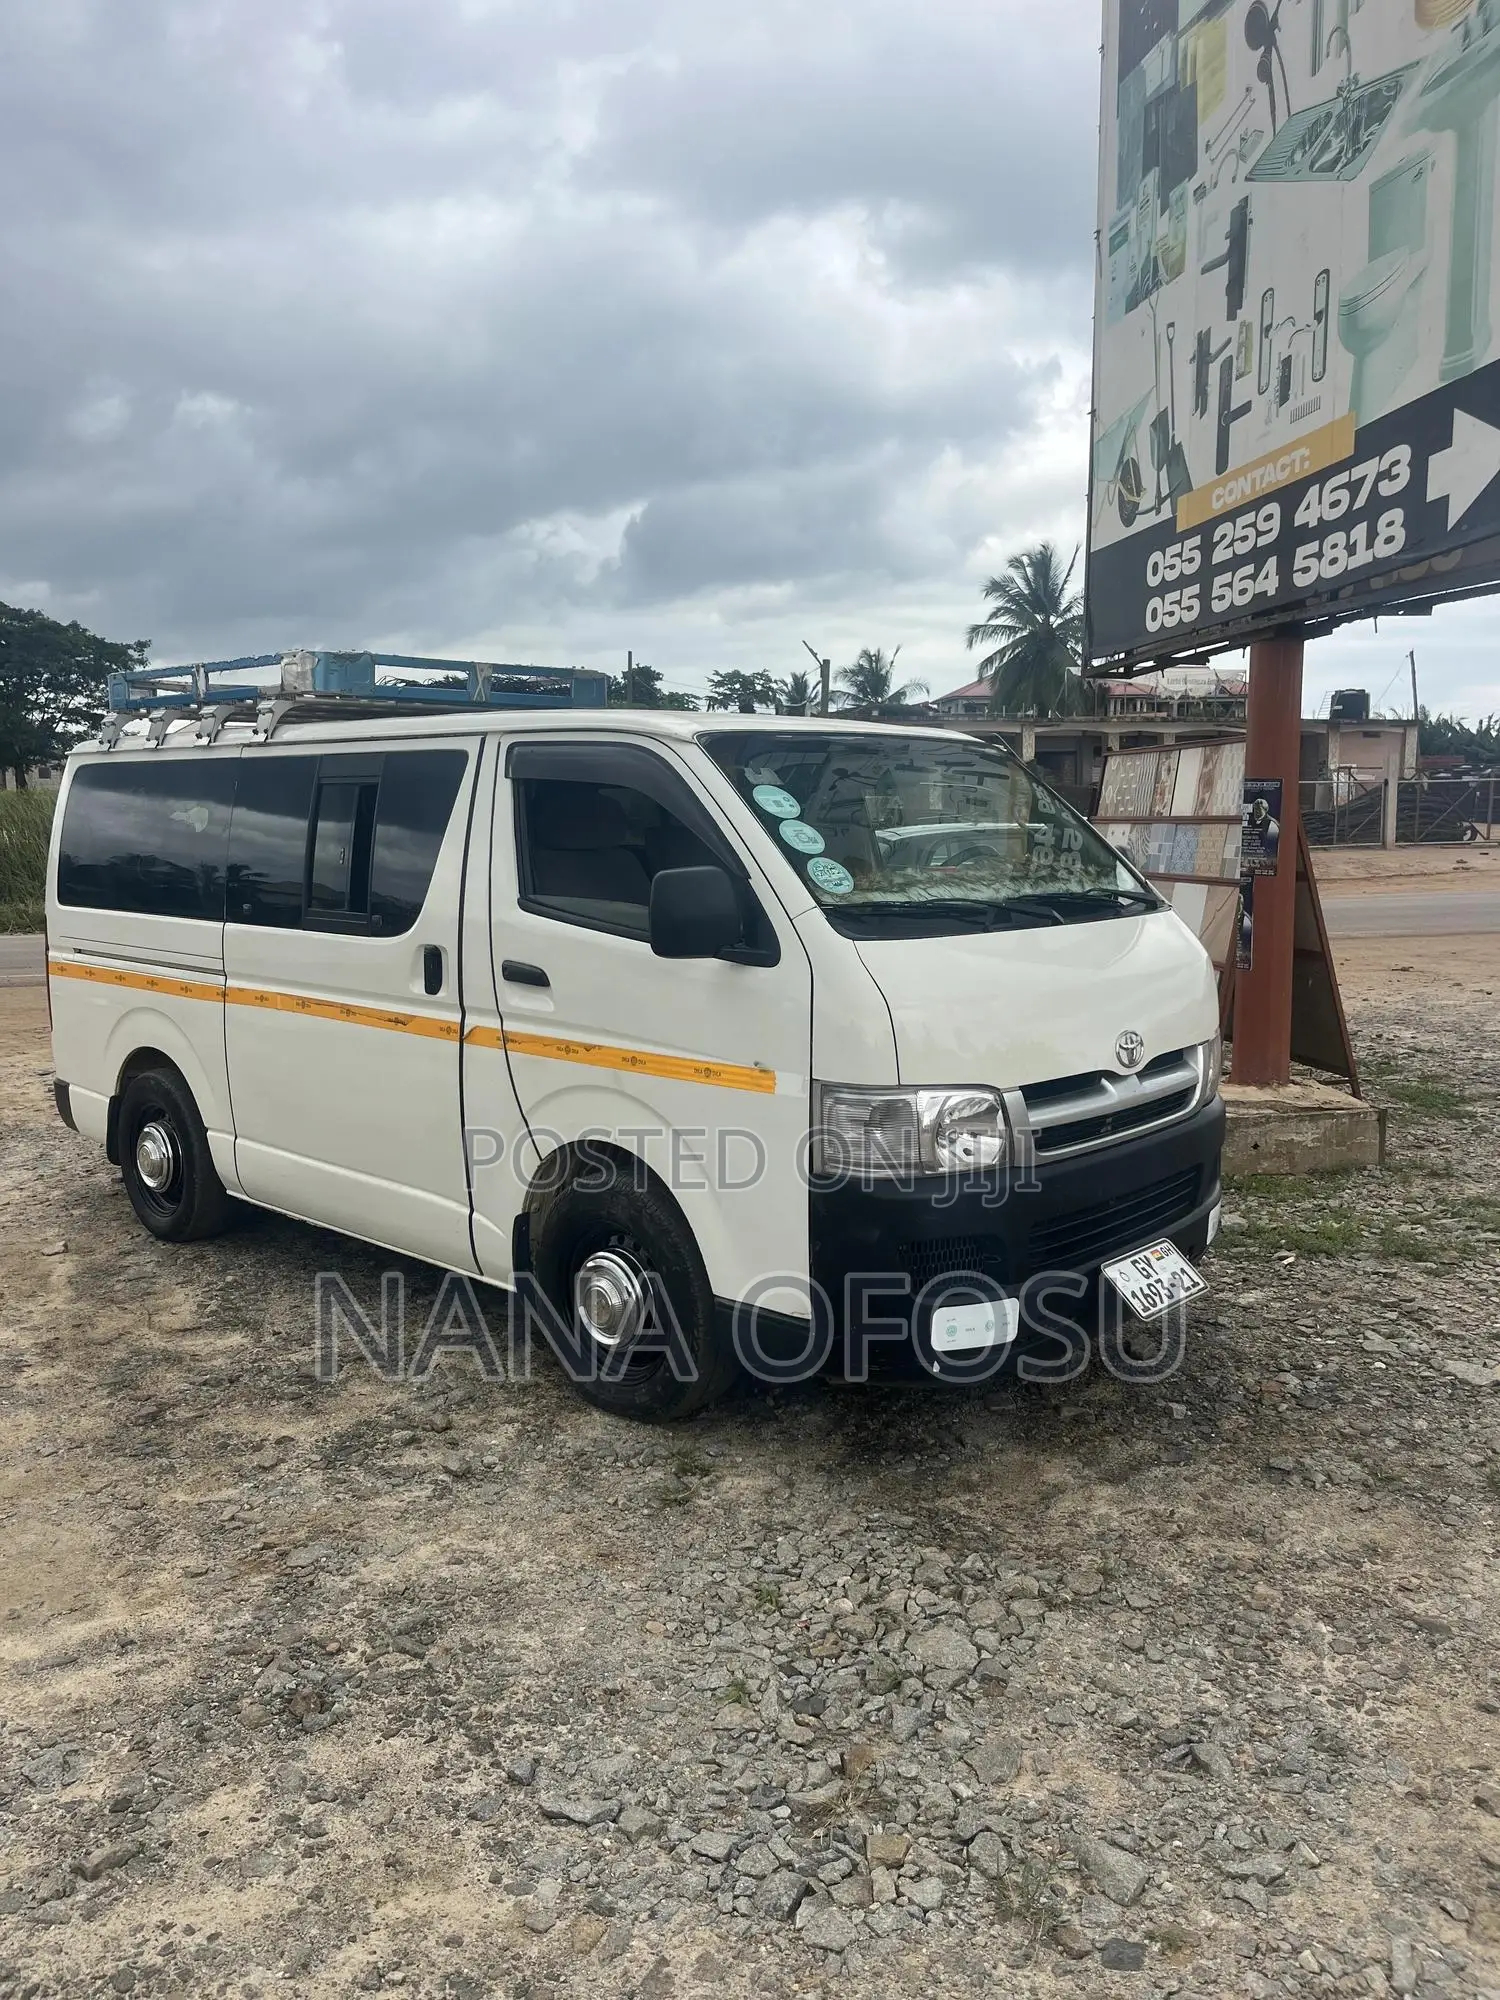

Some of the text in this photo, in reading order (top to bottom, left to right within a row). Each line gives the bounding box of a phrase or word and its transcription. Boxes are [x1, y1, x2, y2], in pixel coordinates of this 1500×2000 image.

[1211, 447, 1311, 510] CONTACT:
[1146, 444, 1412, 587] 055 259 4673
[1145, 584, 1201, 633] 055
[1211, 555, 1279, 613] 564
[1293, 508, 1406, 588] 5818
[1130, 1244, 1175, 1280] GY GH
[1131, 1267, 1200, 1313] 1693-21
